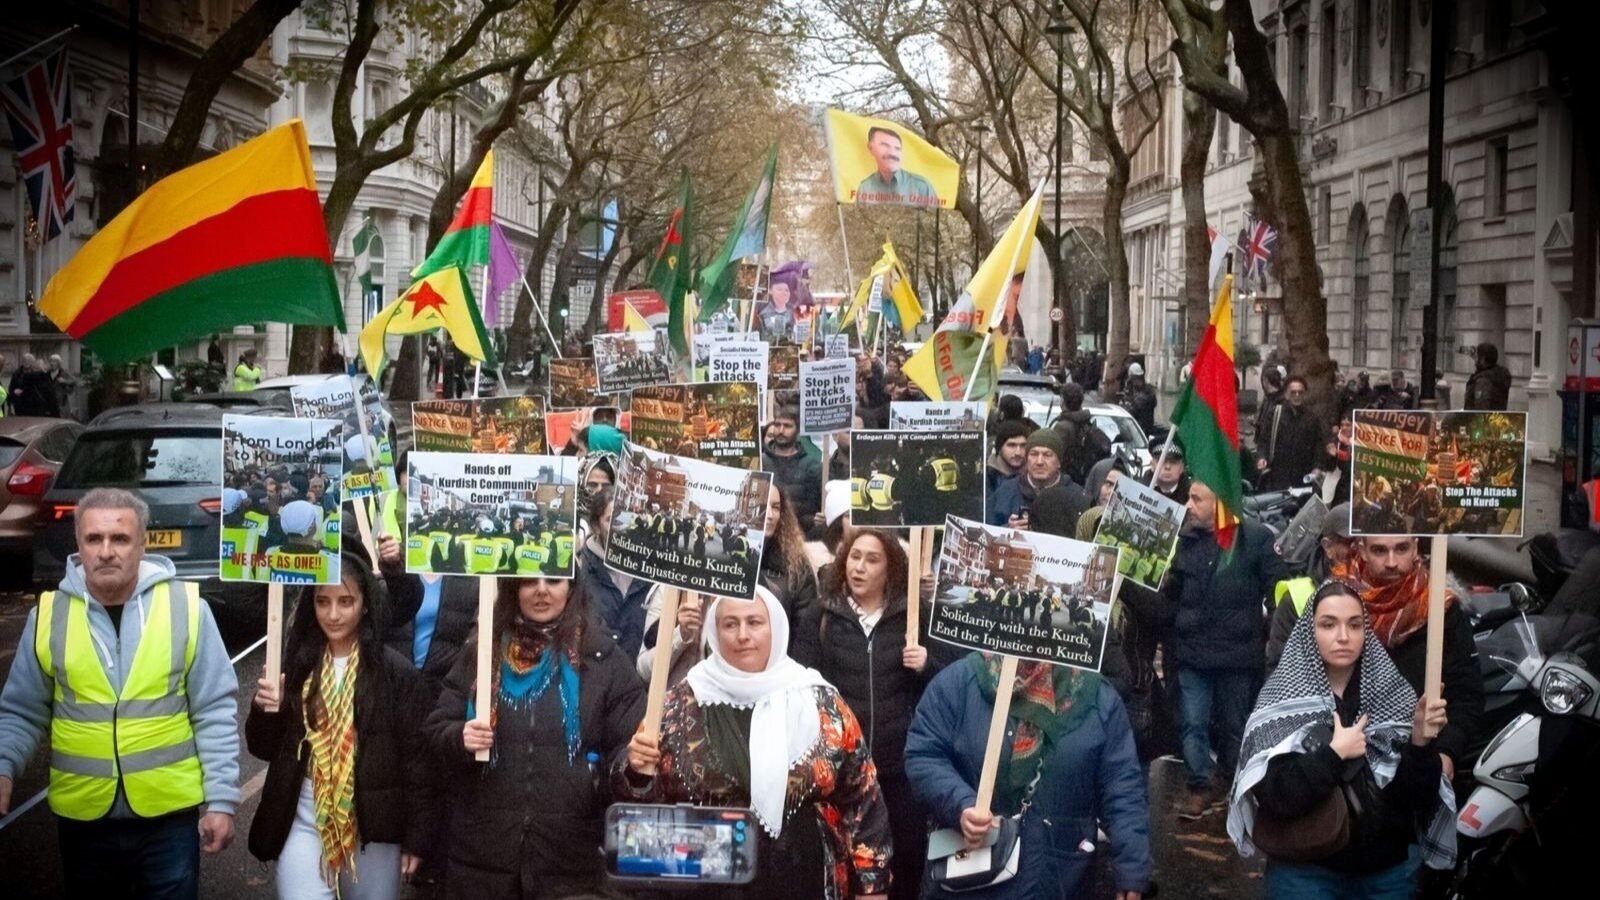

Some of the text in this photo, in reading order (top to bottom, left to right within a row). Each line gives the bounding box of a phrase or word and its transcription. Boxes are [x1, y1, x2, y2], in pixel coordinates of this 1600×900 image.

[713, 359, 761, 373] Stop the
[713, 371, 756, 382] attacks
[805, 377, 830, 388] Stop
[833, 374, 850, 385] the
[805, 386, 845, 398] attacks
[805, 394, 852, 407] on Kurds
[304, 410, 316, 418] to
[662, 406, 679, 417] FOR
[450, 420, 467, 430] FOR
[232, 433, 335, 451] From London
[856, 434, 883, 442] Erdogan
[909, 434, 938, 442] Complies
[942, 433, 960, 441] Kurds
[960, 432, 979, 440] Resist
[700, 440, 755, 450] Stop The Attacks
[1402, 437, 1422, 453] FOR
[235, 449, 250, 461] to
[723, 449, 743, 457] Kurds
[464, 463, 512, 475] Hands off
[438, 475, 538, 492] Kurdish Community
[700, 482, 713, 492] the
[470, 491, 504, 504] Centre
[1445, 486, 1518, 497] Stop The Attacks
[1460, 497, 1500, 508] on Kurds
[149, 532, 174, 544] MZT
[231, 552, 322, 570] WE RISE AS ONE!!
[611, 533, 746, 578] Solidarity with the Kurds,
[1046, 556, 1060, 565] the
[607, 549, 748, 594] End the Injustice on Kurds
[941, 606, 1092, 648] Solidarity with the Kurds,
[936, 621, 1093, 664] End the Injustice on Kurds
[1460, 803, 1482, 831] L
